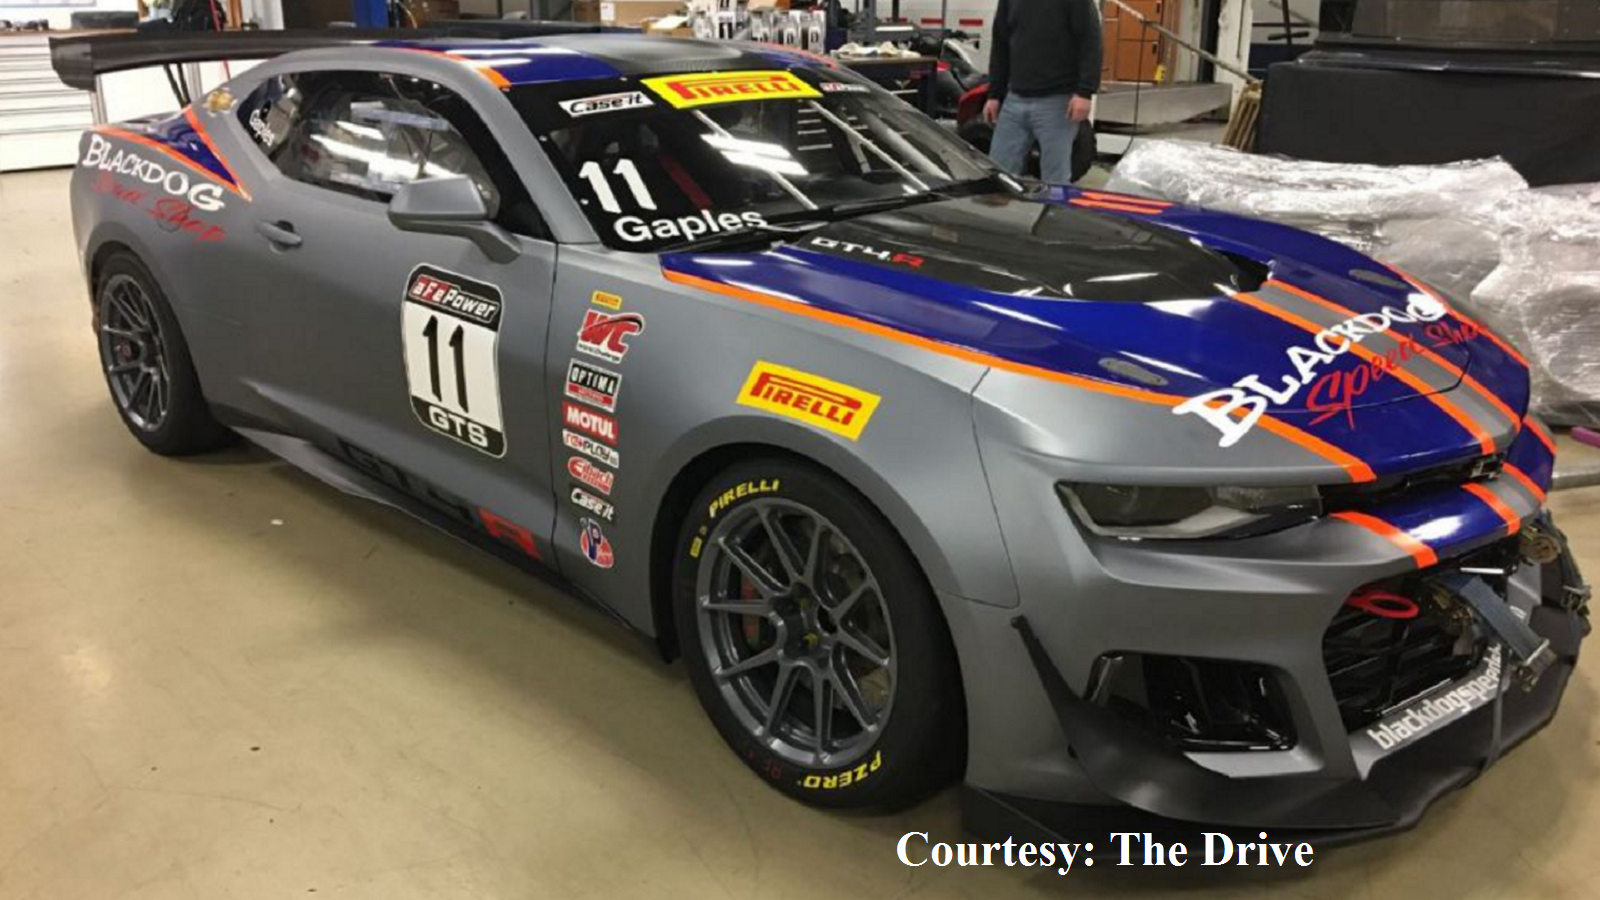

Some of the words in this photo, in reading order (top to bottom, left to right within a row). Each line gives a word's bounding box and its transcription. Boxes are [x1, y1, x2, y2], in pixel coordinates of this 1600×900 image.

[666, 75, 800, 99] PIRELLI
[82, 134, 225, 212] BLACKDOG
[579, 158, 657, 214] 11
[613, 209, 767, 243] Gaples
[422, 314, 469, 414] 11
[571, 367, 614, 394] OPTIMA
[1172, 292, 1447, 447] BLACKDOG
[1306, 333, 1424, 429] Speed
[567, 405, 615, 439] MOTUL
[750, 372, 862, 425] PIRELLI
[428, 405, 489, 448] GTS
[709, 479, 780, 518] PIRELLI
